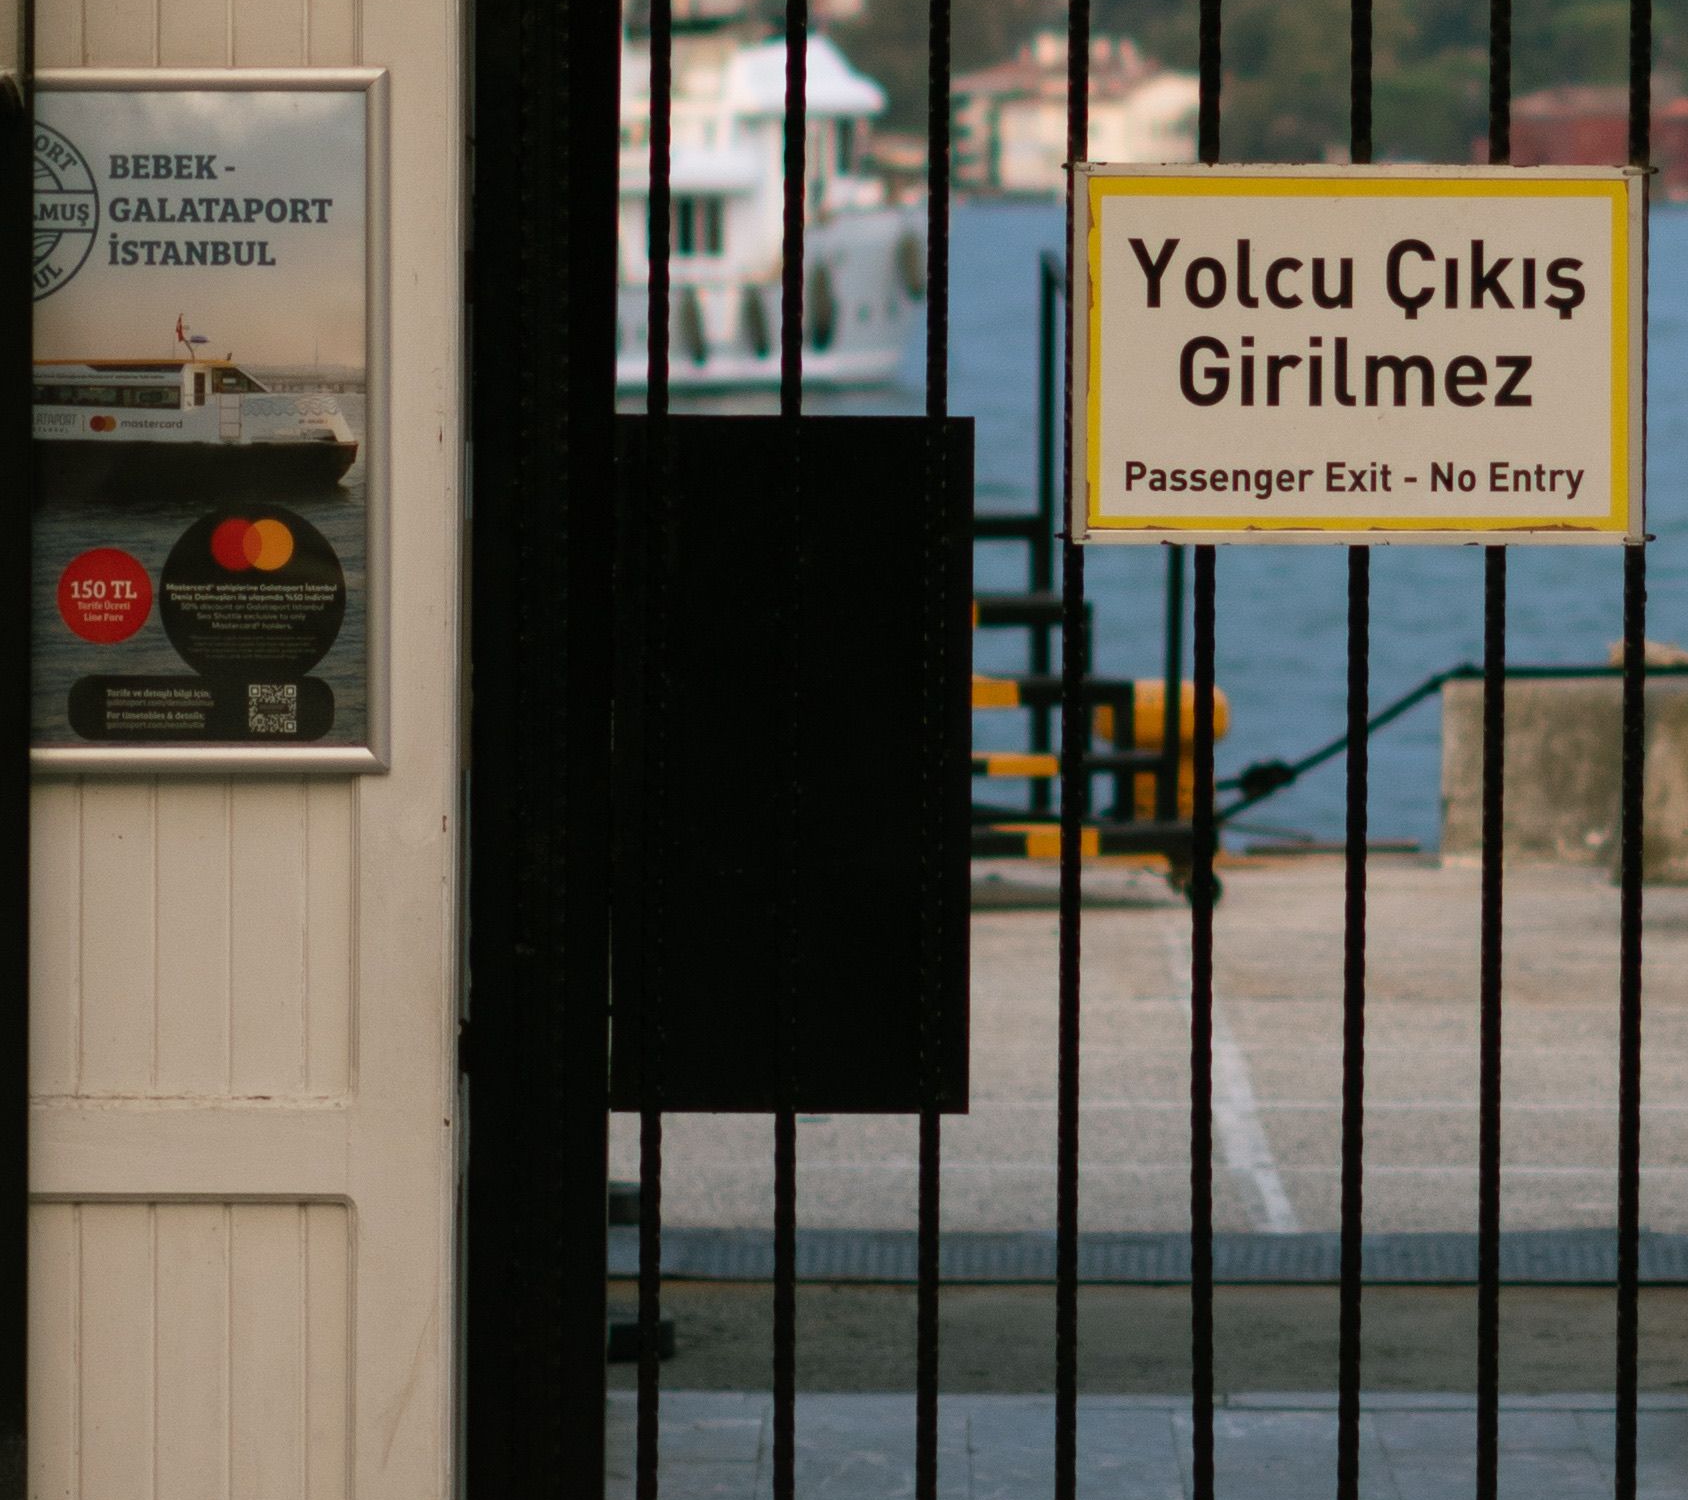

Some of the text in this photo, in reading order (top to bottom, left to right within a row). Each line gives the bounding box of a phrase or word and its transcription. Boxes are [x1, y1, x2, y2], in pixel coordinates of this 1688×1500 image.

[108, 154, 218, 180] BEBEK
[33, 202, 90, 227] MUŞ
[108, 197, 333, 224] GALATAPORT
[108, 233, 276, 266] İSTANBUL
[1128, 238, 1586, 320] Yolcu Çıkış
[1179, 335, 1533, 407] Girilmez
[33, 413, 77, 426] ATAPORT
[120, 418, 184, 430] mastercard
[1125, 461, 1314, 500] Passenger
[1326, 461, 1392, 492] Exit
[1430, 461, 1477, 493] No
[1489, 461, 1585, 500] Entry
[71, 579, 138, 599] 150 TL
[83, 612, 124, 622] Line Fare
